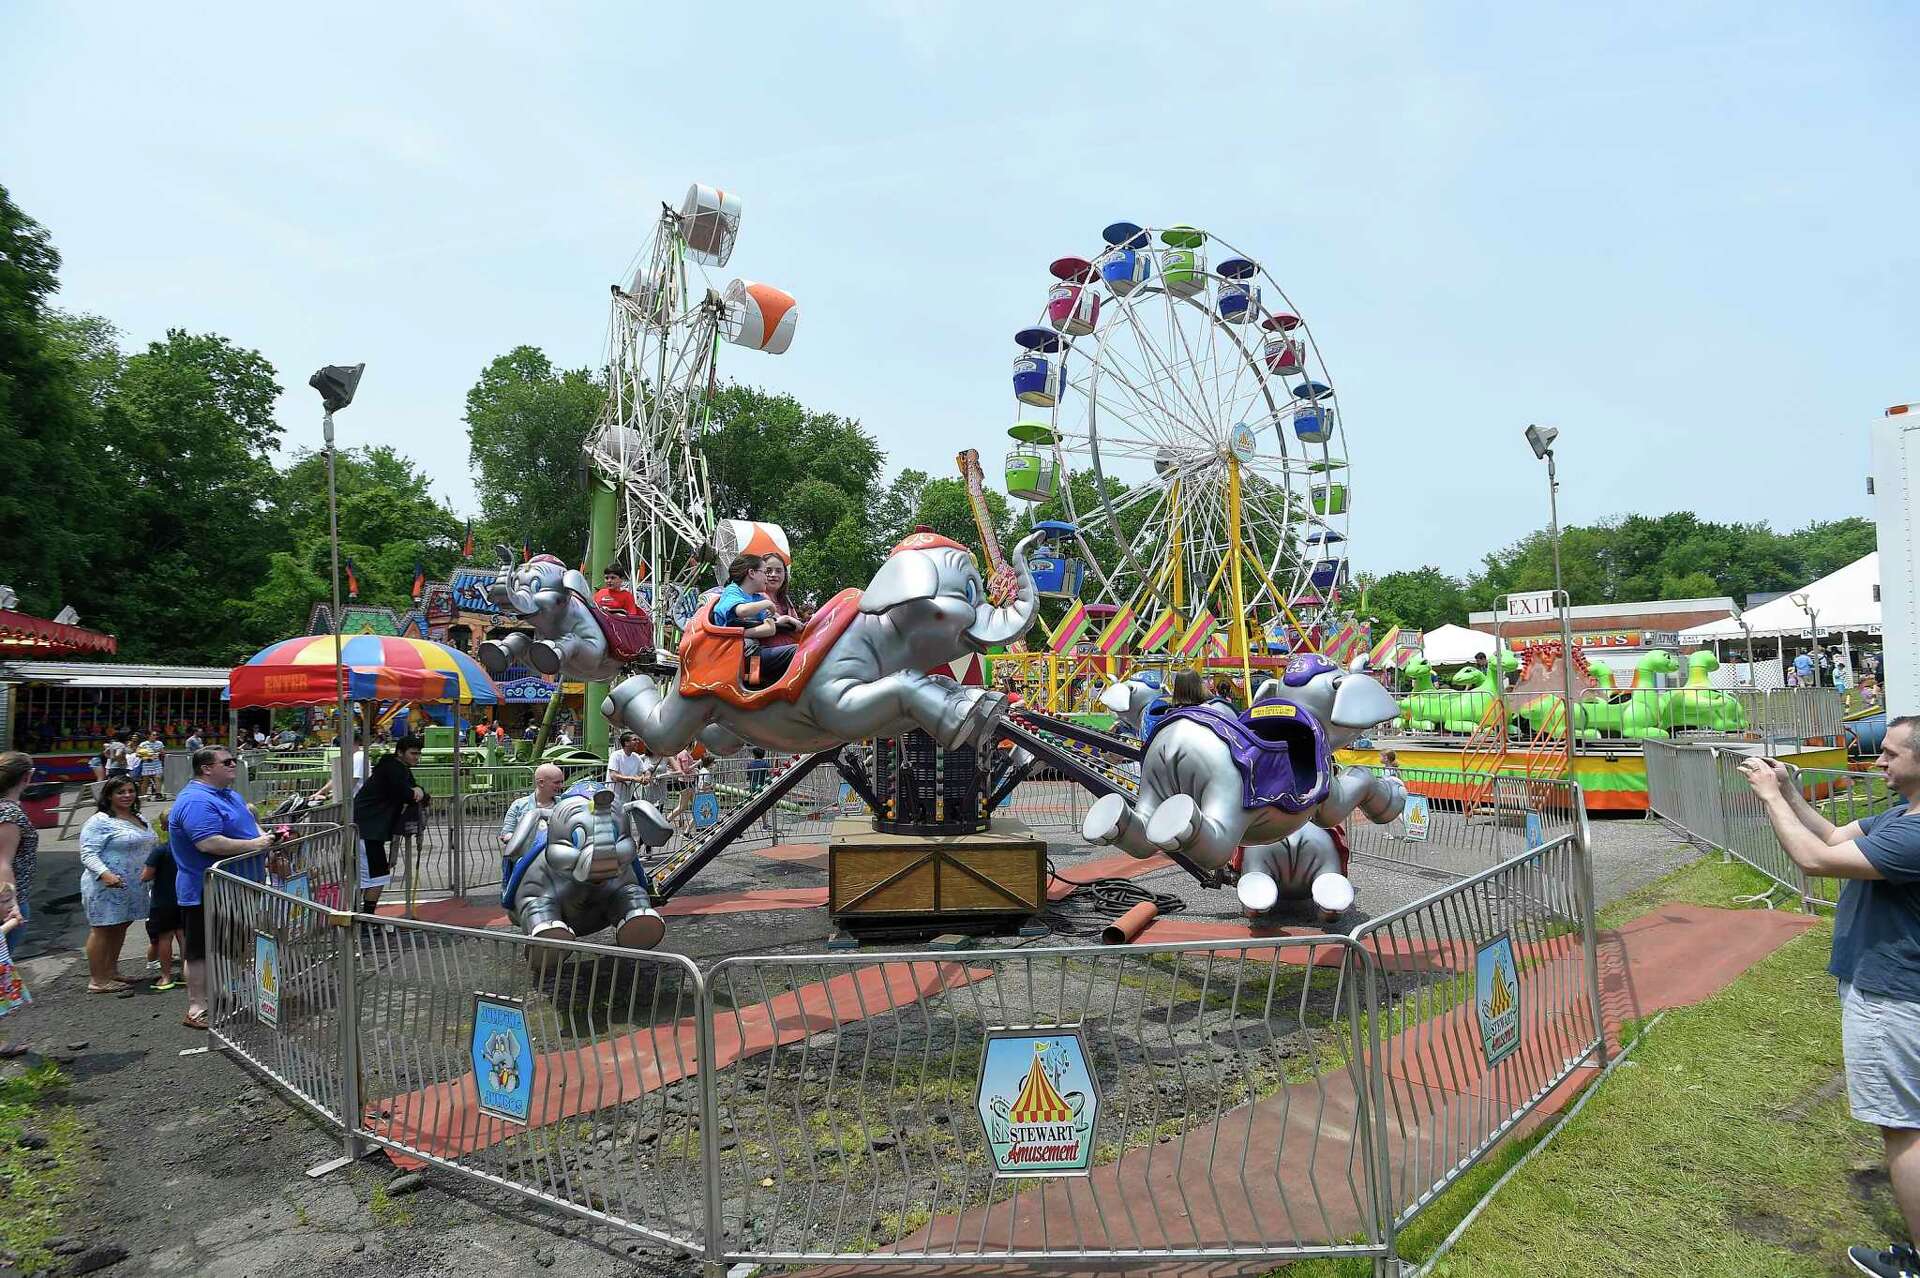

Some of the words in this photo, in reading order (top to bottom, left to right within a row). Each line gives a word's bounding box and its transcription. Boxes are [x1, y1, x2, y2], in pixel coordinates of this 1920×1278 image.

[1509, 596, 1553, 616] EXIT
[1803, 628, 1826, 637] ENER
[264, 673, 308, 695] ENTER
[485, 1089, 524, 1114] JUMBOS
[1009, 1125, 1075, 1143] STEWART
[1001, 1140, 1080, 1165] Amusement
